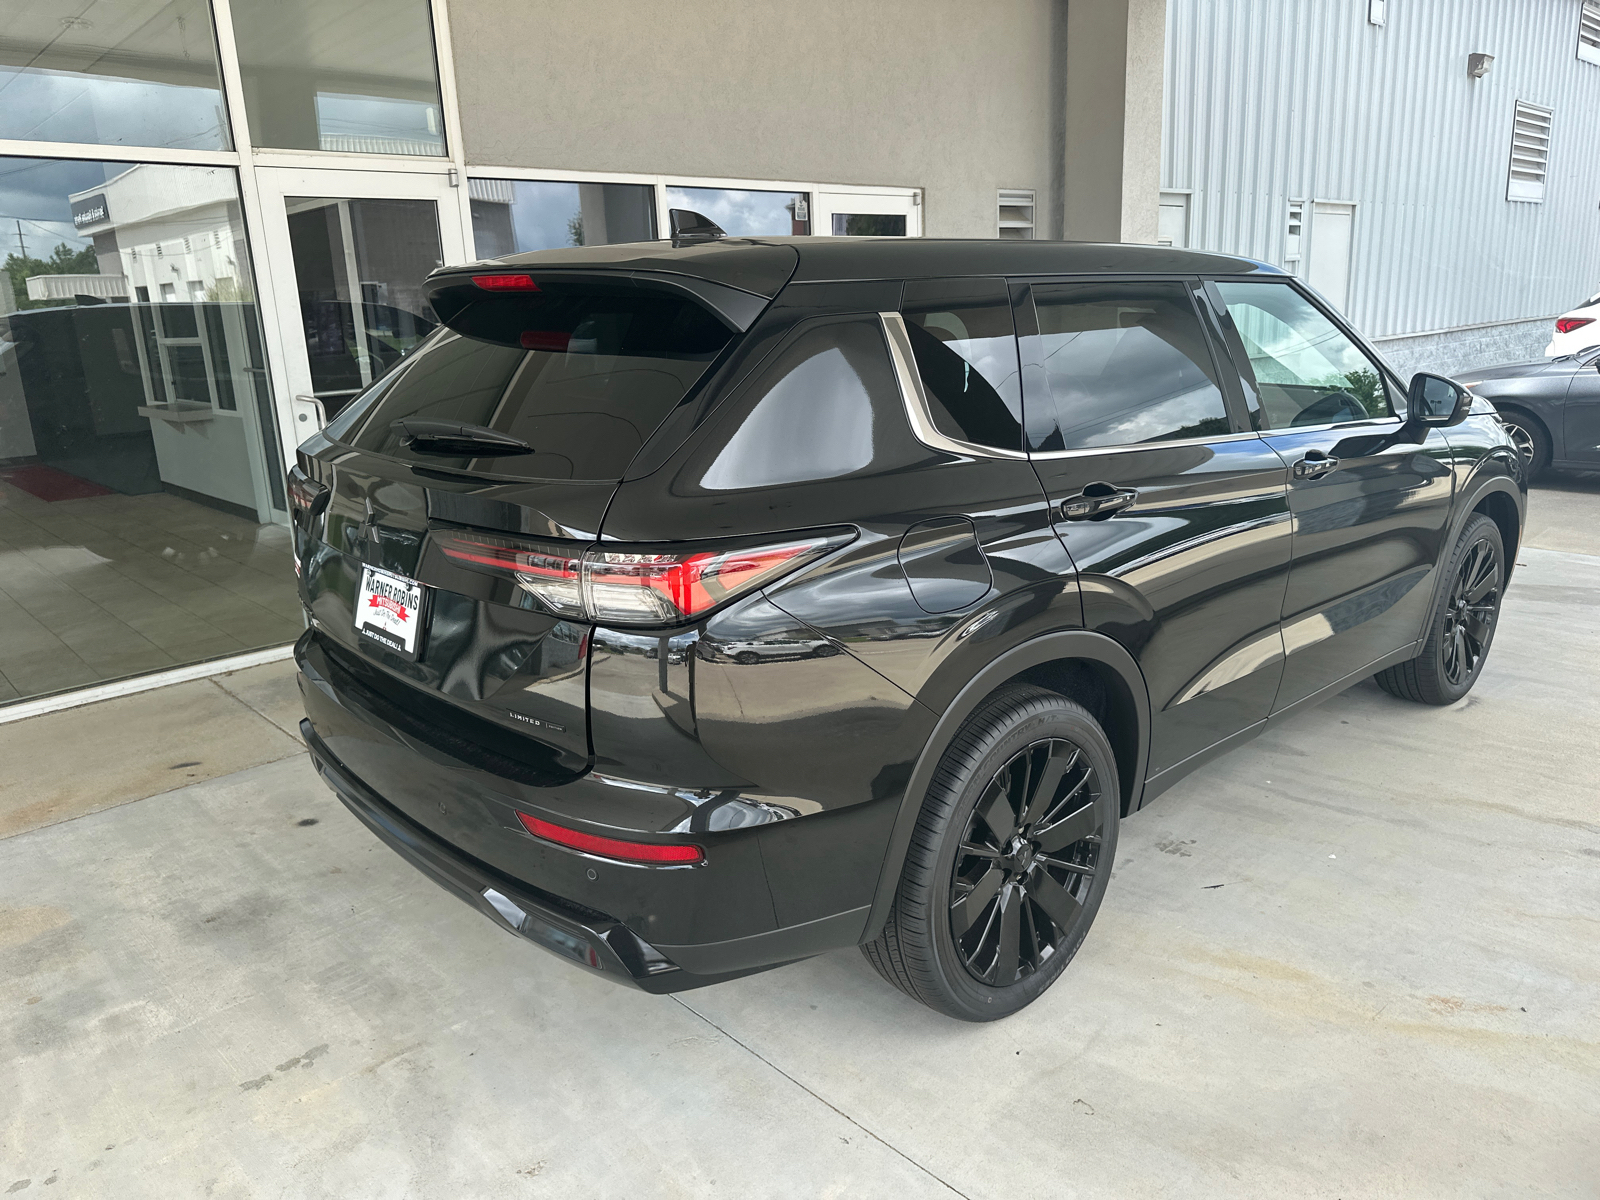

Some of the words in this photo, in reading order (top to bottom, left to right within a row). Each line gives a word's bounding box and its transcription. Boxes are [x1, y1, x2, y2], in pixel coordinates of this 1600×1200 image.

[366, 576, 393, 599] WARNER
[393, 586, 419, 611] ROBINS
[376, 597, 402, 615] MITSUBISHI
[509, 712, 541, 726] LIMITED
